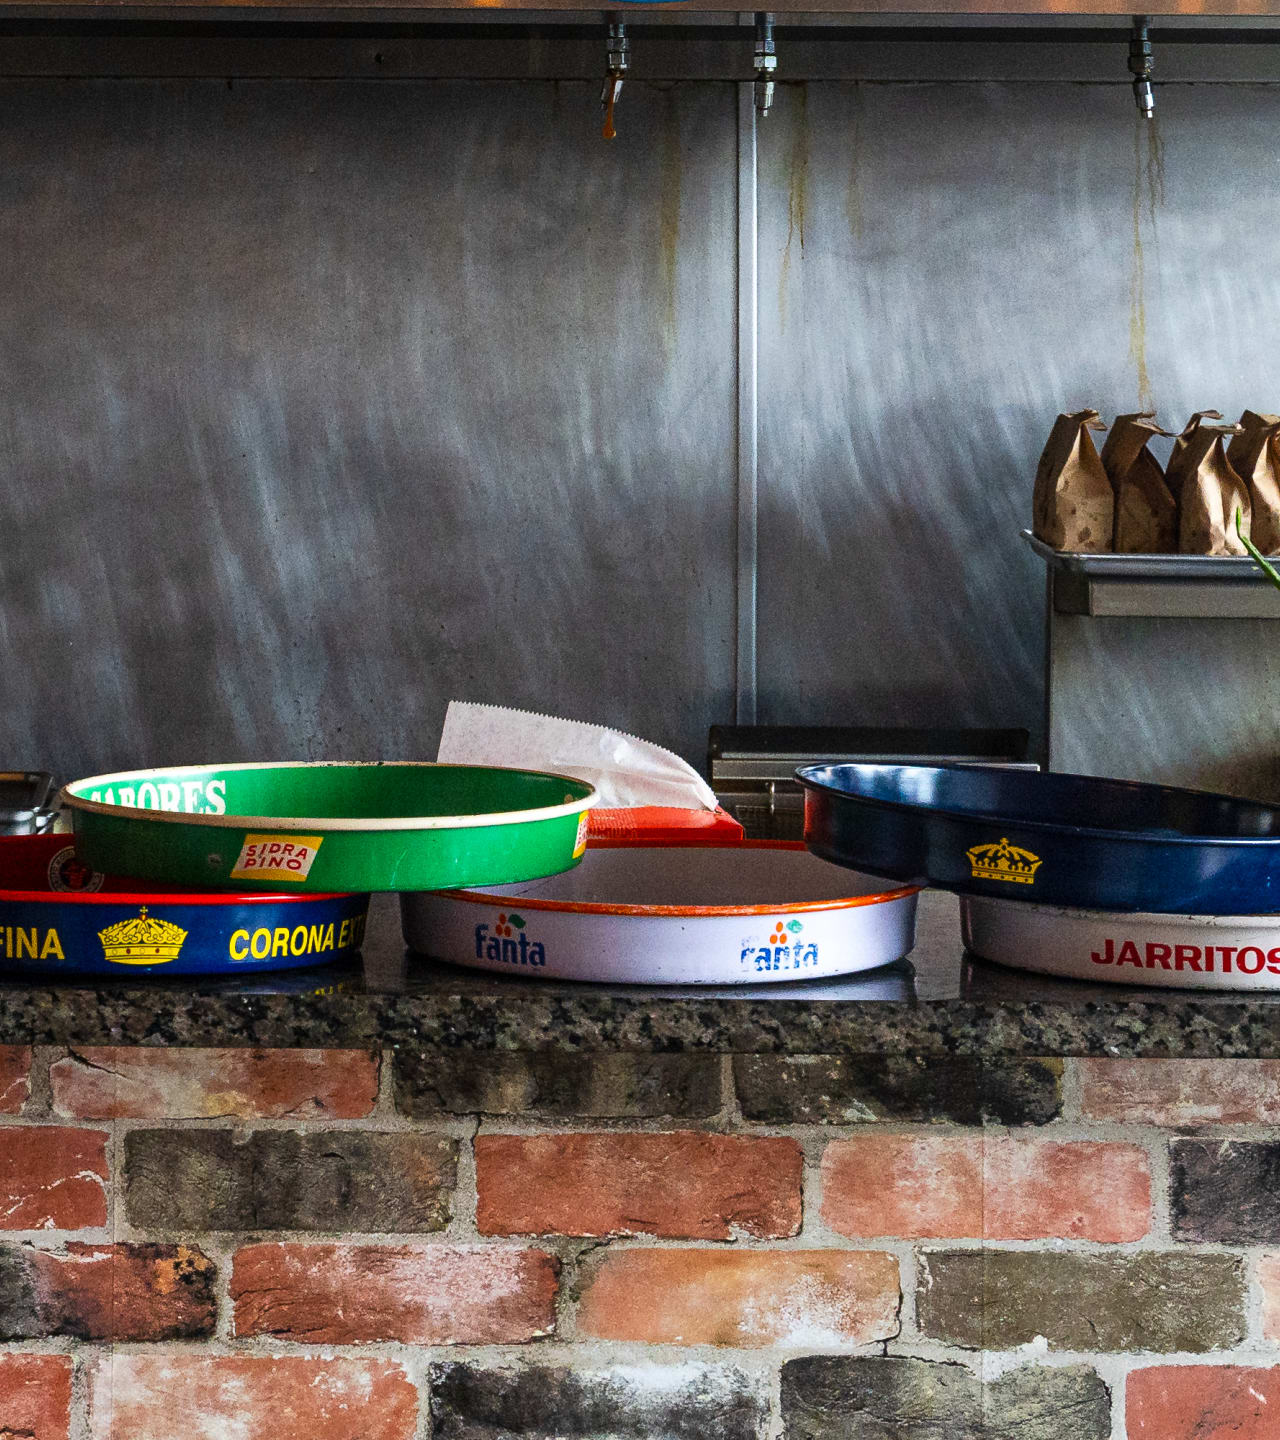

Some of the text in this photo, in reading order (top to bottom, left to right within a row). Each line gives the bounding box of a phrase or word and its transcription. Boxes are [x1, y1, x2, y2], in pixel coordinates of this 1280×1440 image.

[246, 842, 308, 859] SIDRA
[244, 857, 302, 870] PINO
[230, 922, 334, 960] CORONA
